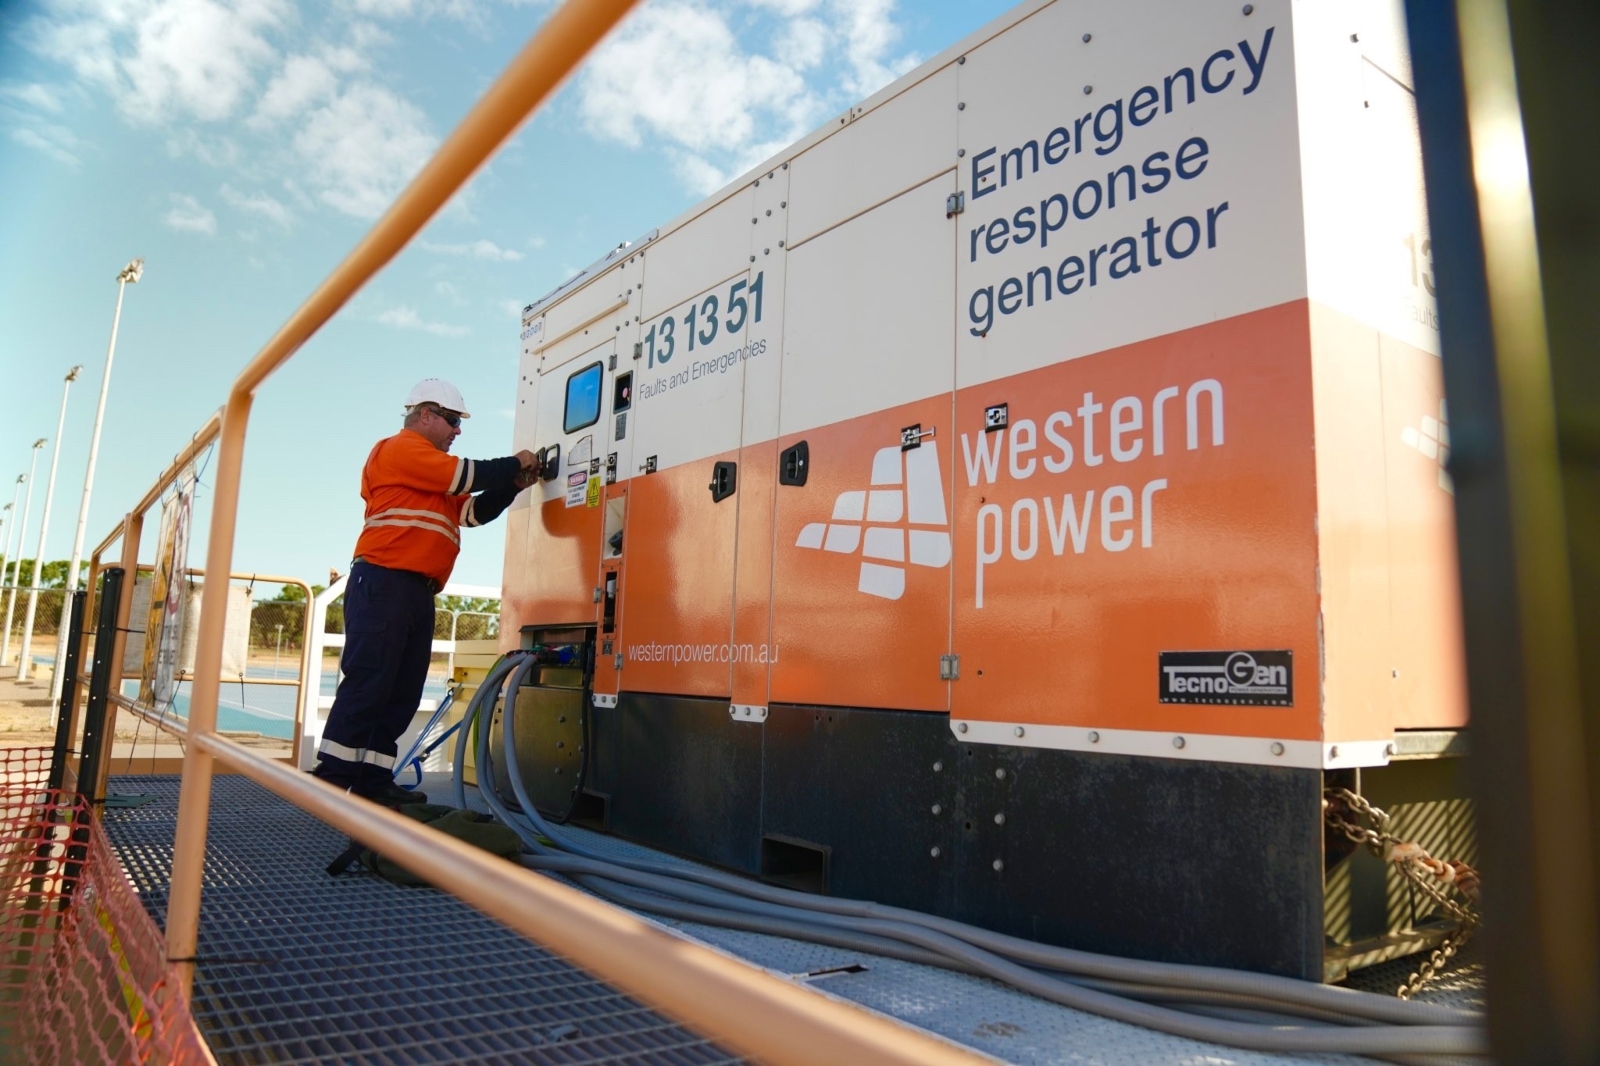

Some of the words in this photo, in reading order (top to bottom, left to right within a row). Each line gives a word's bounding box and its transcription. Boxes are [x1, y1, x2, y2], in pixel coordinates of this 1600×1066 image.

[972, 26, 1276, 200] Emergency
[970, 137, 1210, 262] response
[645, 316, 676, 369] 13
[684, 295, 719, 351] 13
[726, 271, 764, 333] 51
[969, 202, 1229, 338] generator
[639, 378, 667, 401] Faults
[669, 366, 689, 390] and
[692, 338, 767, 381] Emergencies
[961, 379, 1224, 487] western
[976, 479, 1168, 609] power
[628, 641, 778, 666] westernpower.com.au
[1163, 652, 1287, 693] TecnoGen
